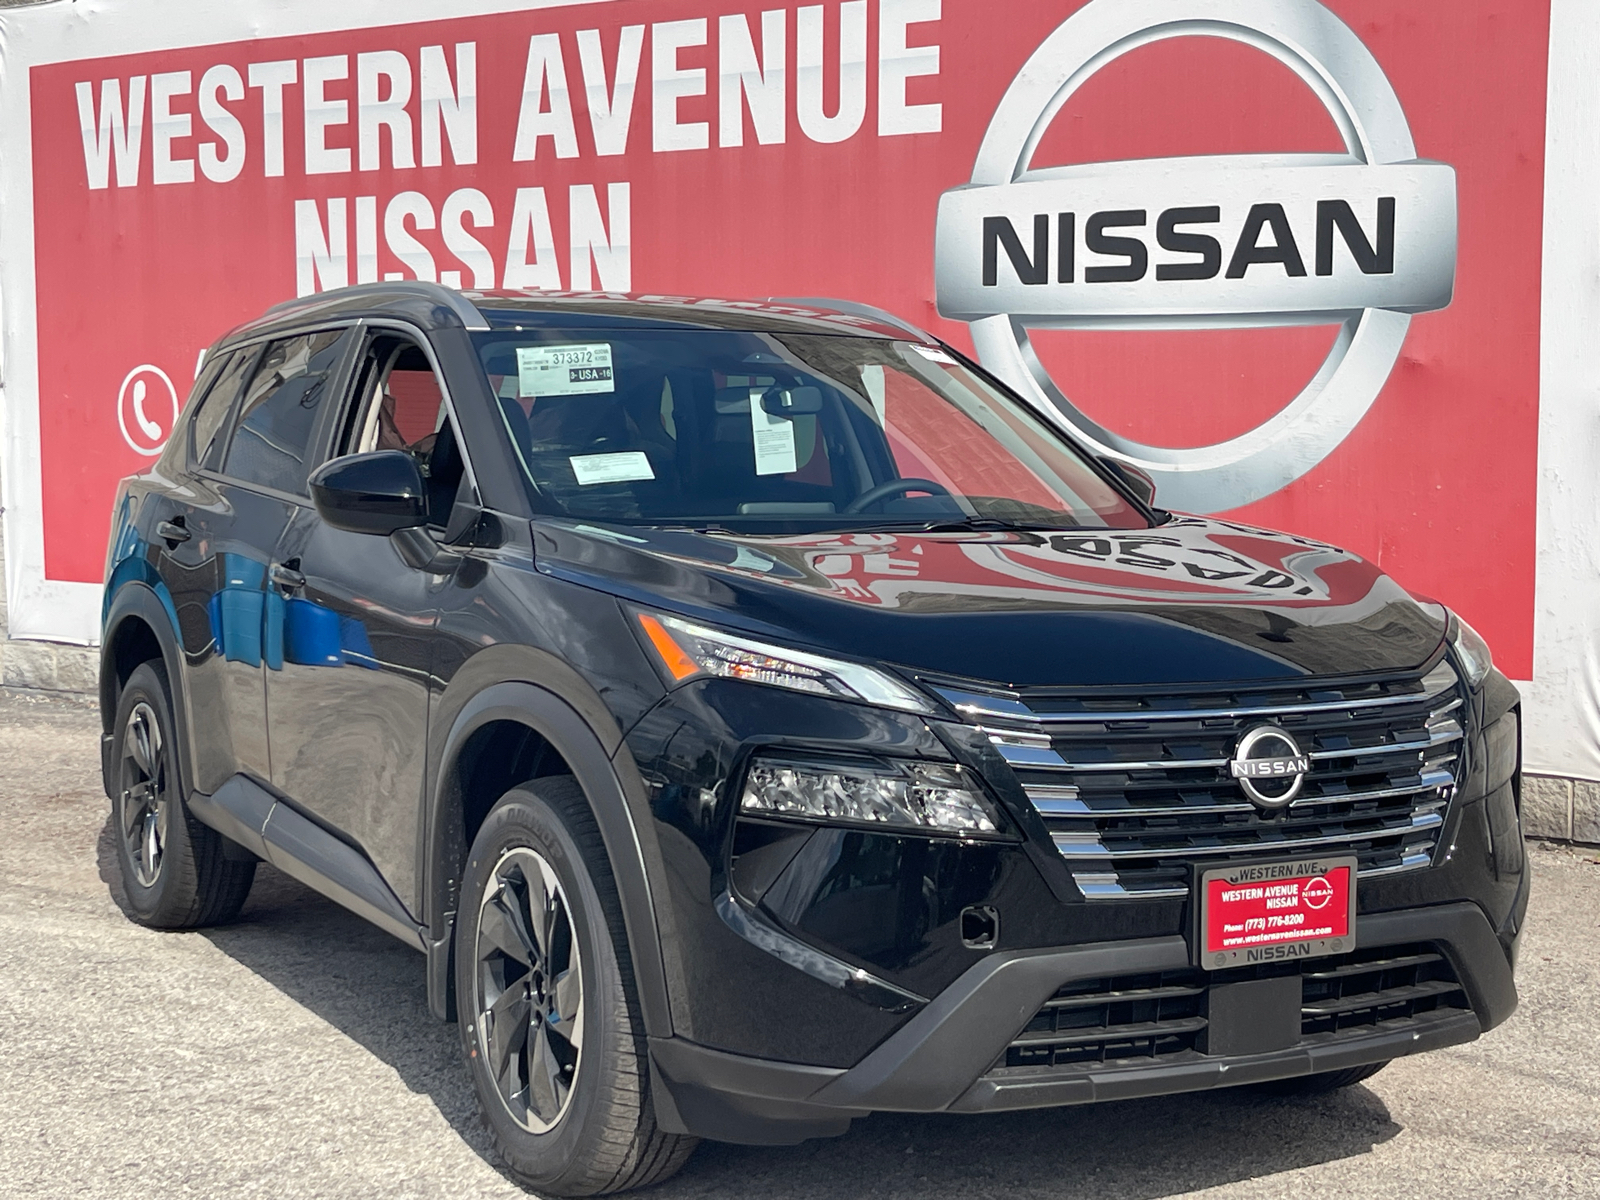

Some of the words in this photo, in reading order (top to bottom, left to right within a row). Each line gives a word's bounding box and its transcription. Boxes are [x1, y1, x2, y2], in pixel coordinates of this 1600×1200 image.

[75, 42, 478, 190] WESTERN
[513, 0, 943, 162] AVENUE
[295, 182, 631, 298] NISSAN
[982, 197, 1396, 287] NISSAN
[552, 352, 592, 364] 373372
[579, 369, 599, 380] USA
[1234, 758, 1308, 775] NISSAN
[1240, 864, 1293, 881] WESTERN
[1221, 888, 1263, 902] WESTERN
[1264, 884, 1298, 898] AVENUE
[1302, 889, 1333, 897] NISSAN
[1266, 896, 1298, 909] NISSAN
[1223, 923, 1244, 933] Phone:
[1245, 917, 1266, 933] (773)
[1267, 913, 1305, 928] 776-8200
[1223, 926, 1332, 947] www.westernavenissan.com
[1247, 942, 1310, 962] NISSAN
